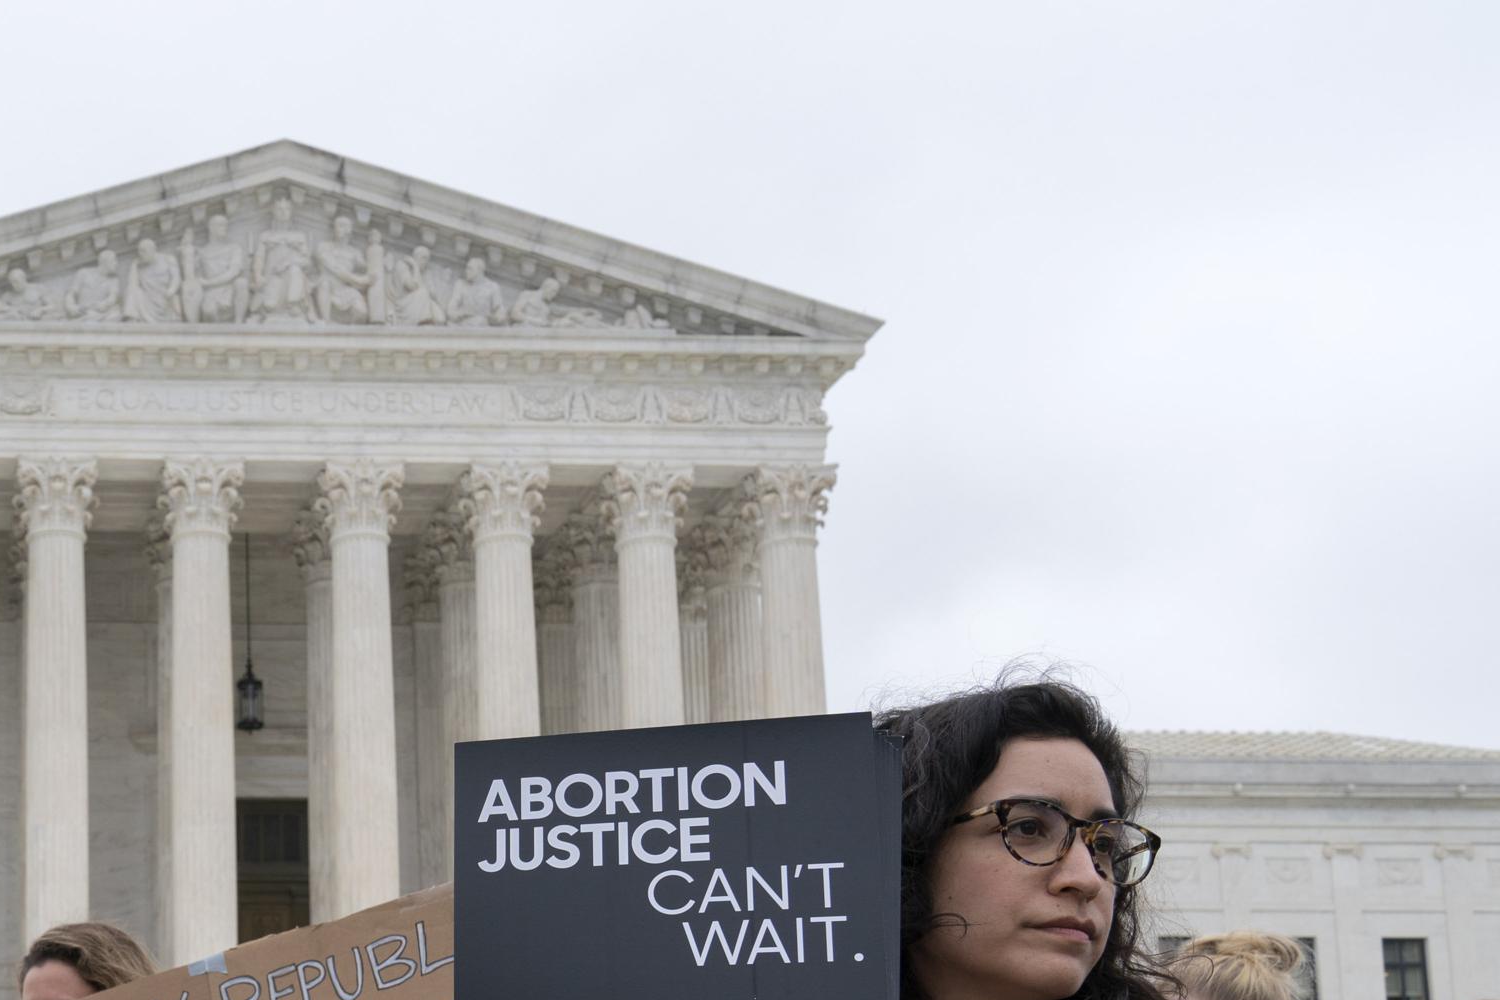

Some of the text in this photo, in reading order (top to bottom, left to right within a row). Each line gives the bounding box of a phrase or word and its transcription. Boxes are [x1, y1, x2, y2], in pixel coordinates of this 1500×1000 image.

[77, 388, 487, 415] EQUAL JUSTICE UNDER LAW
[478, 760, 787, 822] ABORTION
[478, 817, 710, 873] JUSTICE
[648, 863, 845, 915] CAN'T
[682, 916, 865, 966] WAIT.
